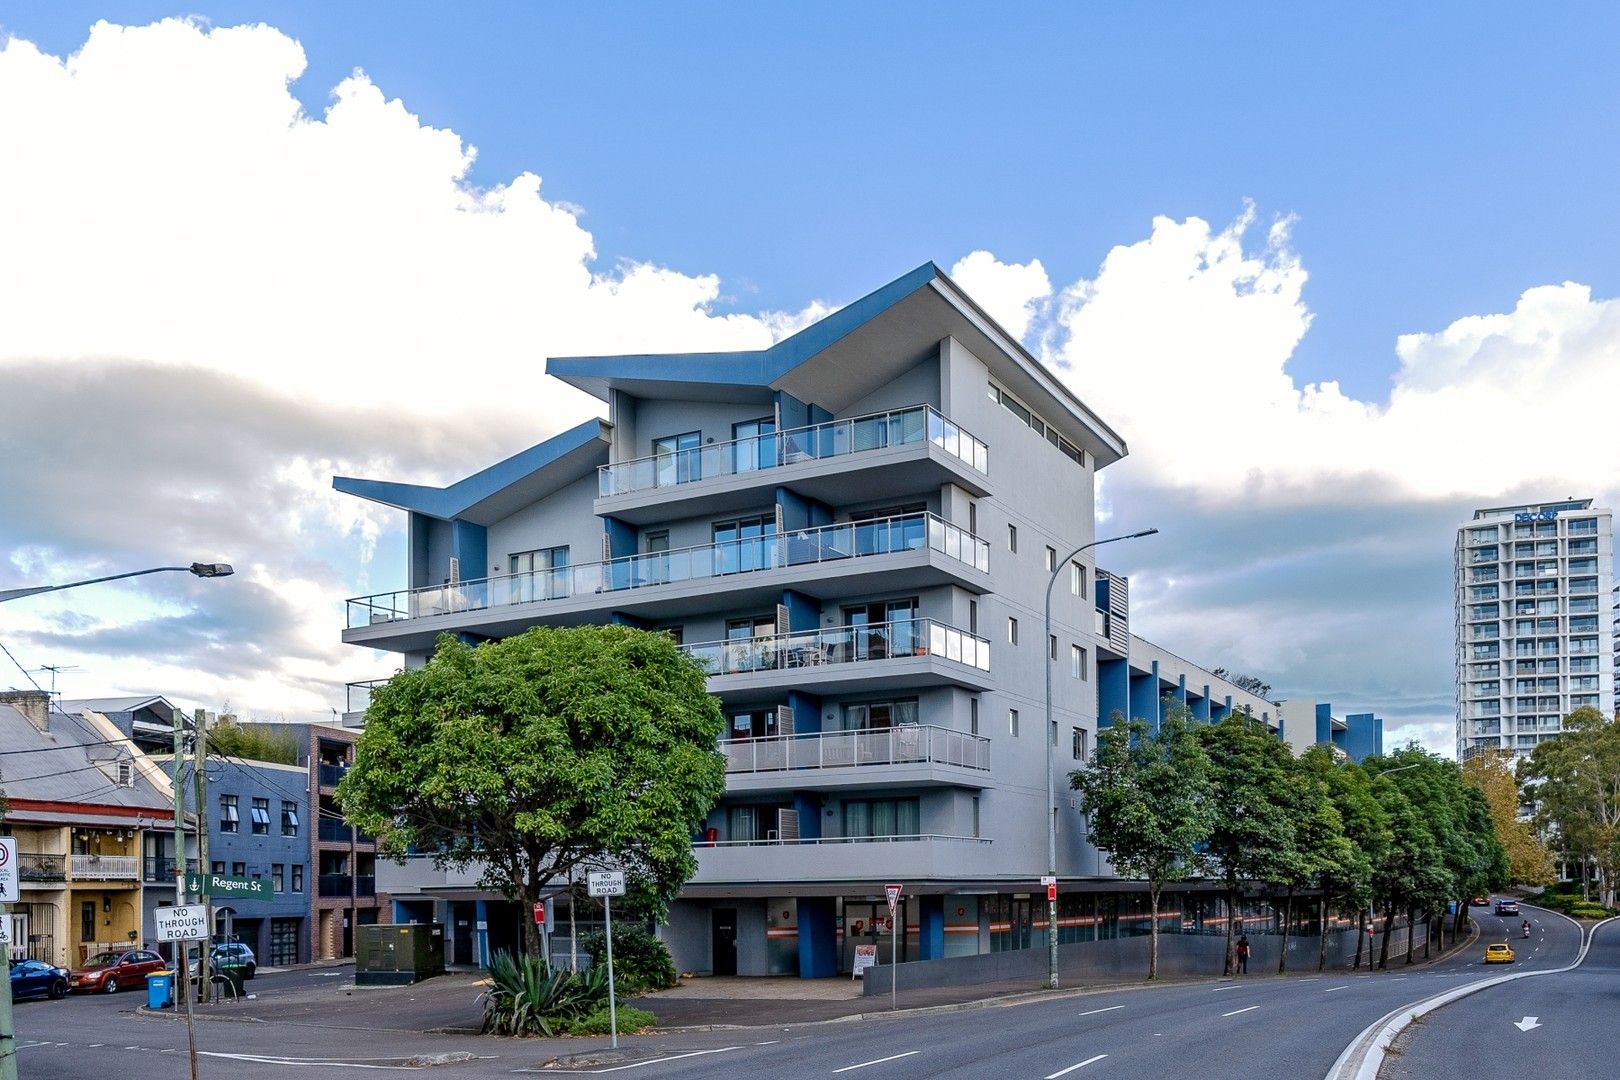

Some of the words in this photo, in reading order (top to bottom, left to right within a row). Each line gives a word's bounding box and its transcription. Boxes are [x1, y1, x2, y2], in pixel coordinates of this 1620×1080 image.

[212, 876, 249, 890] Regent
[250, 880, 262, 891] St
[173, 908, 188, 917] NO
[159, 917, 205, 929] THROUGH
[167, 928, 198, 938] ROAD
